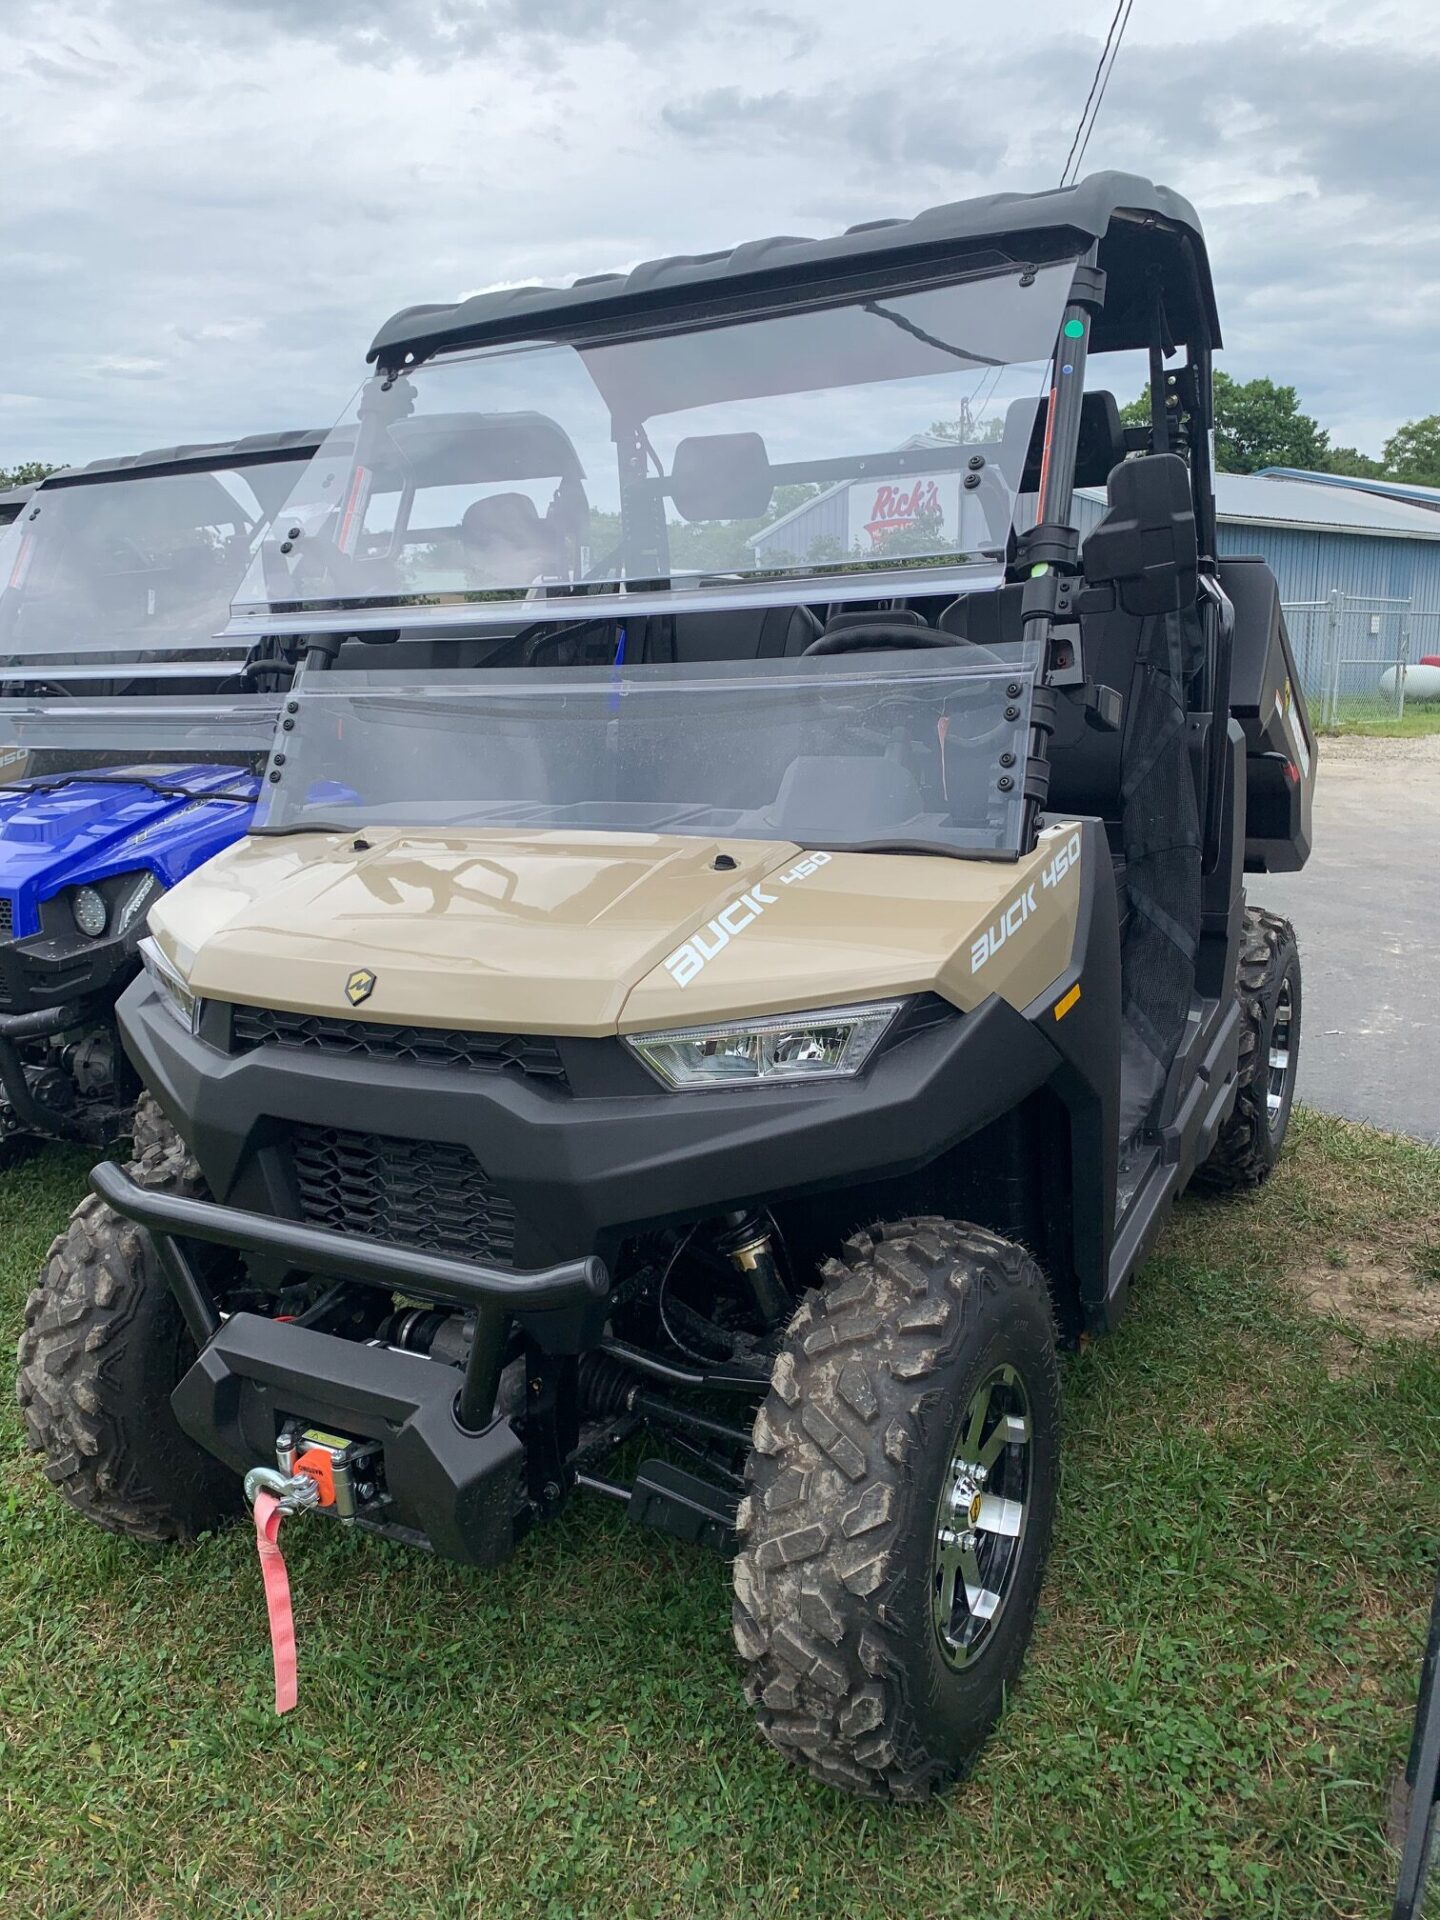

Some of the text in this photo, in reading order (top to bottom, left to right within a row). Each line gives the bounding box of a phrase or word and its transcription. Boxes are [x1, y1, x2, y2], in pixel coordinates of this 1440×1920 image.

[871, 480, 943, 521] Rick's
[664, 851, 833, 988] BUCK 450
[971, 832, 1081, 974] BUCK 450
